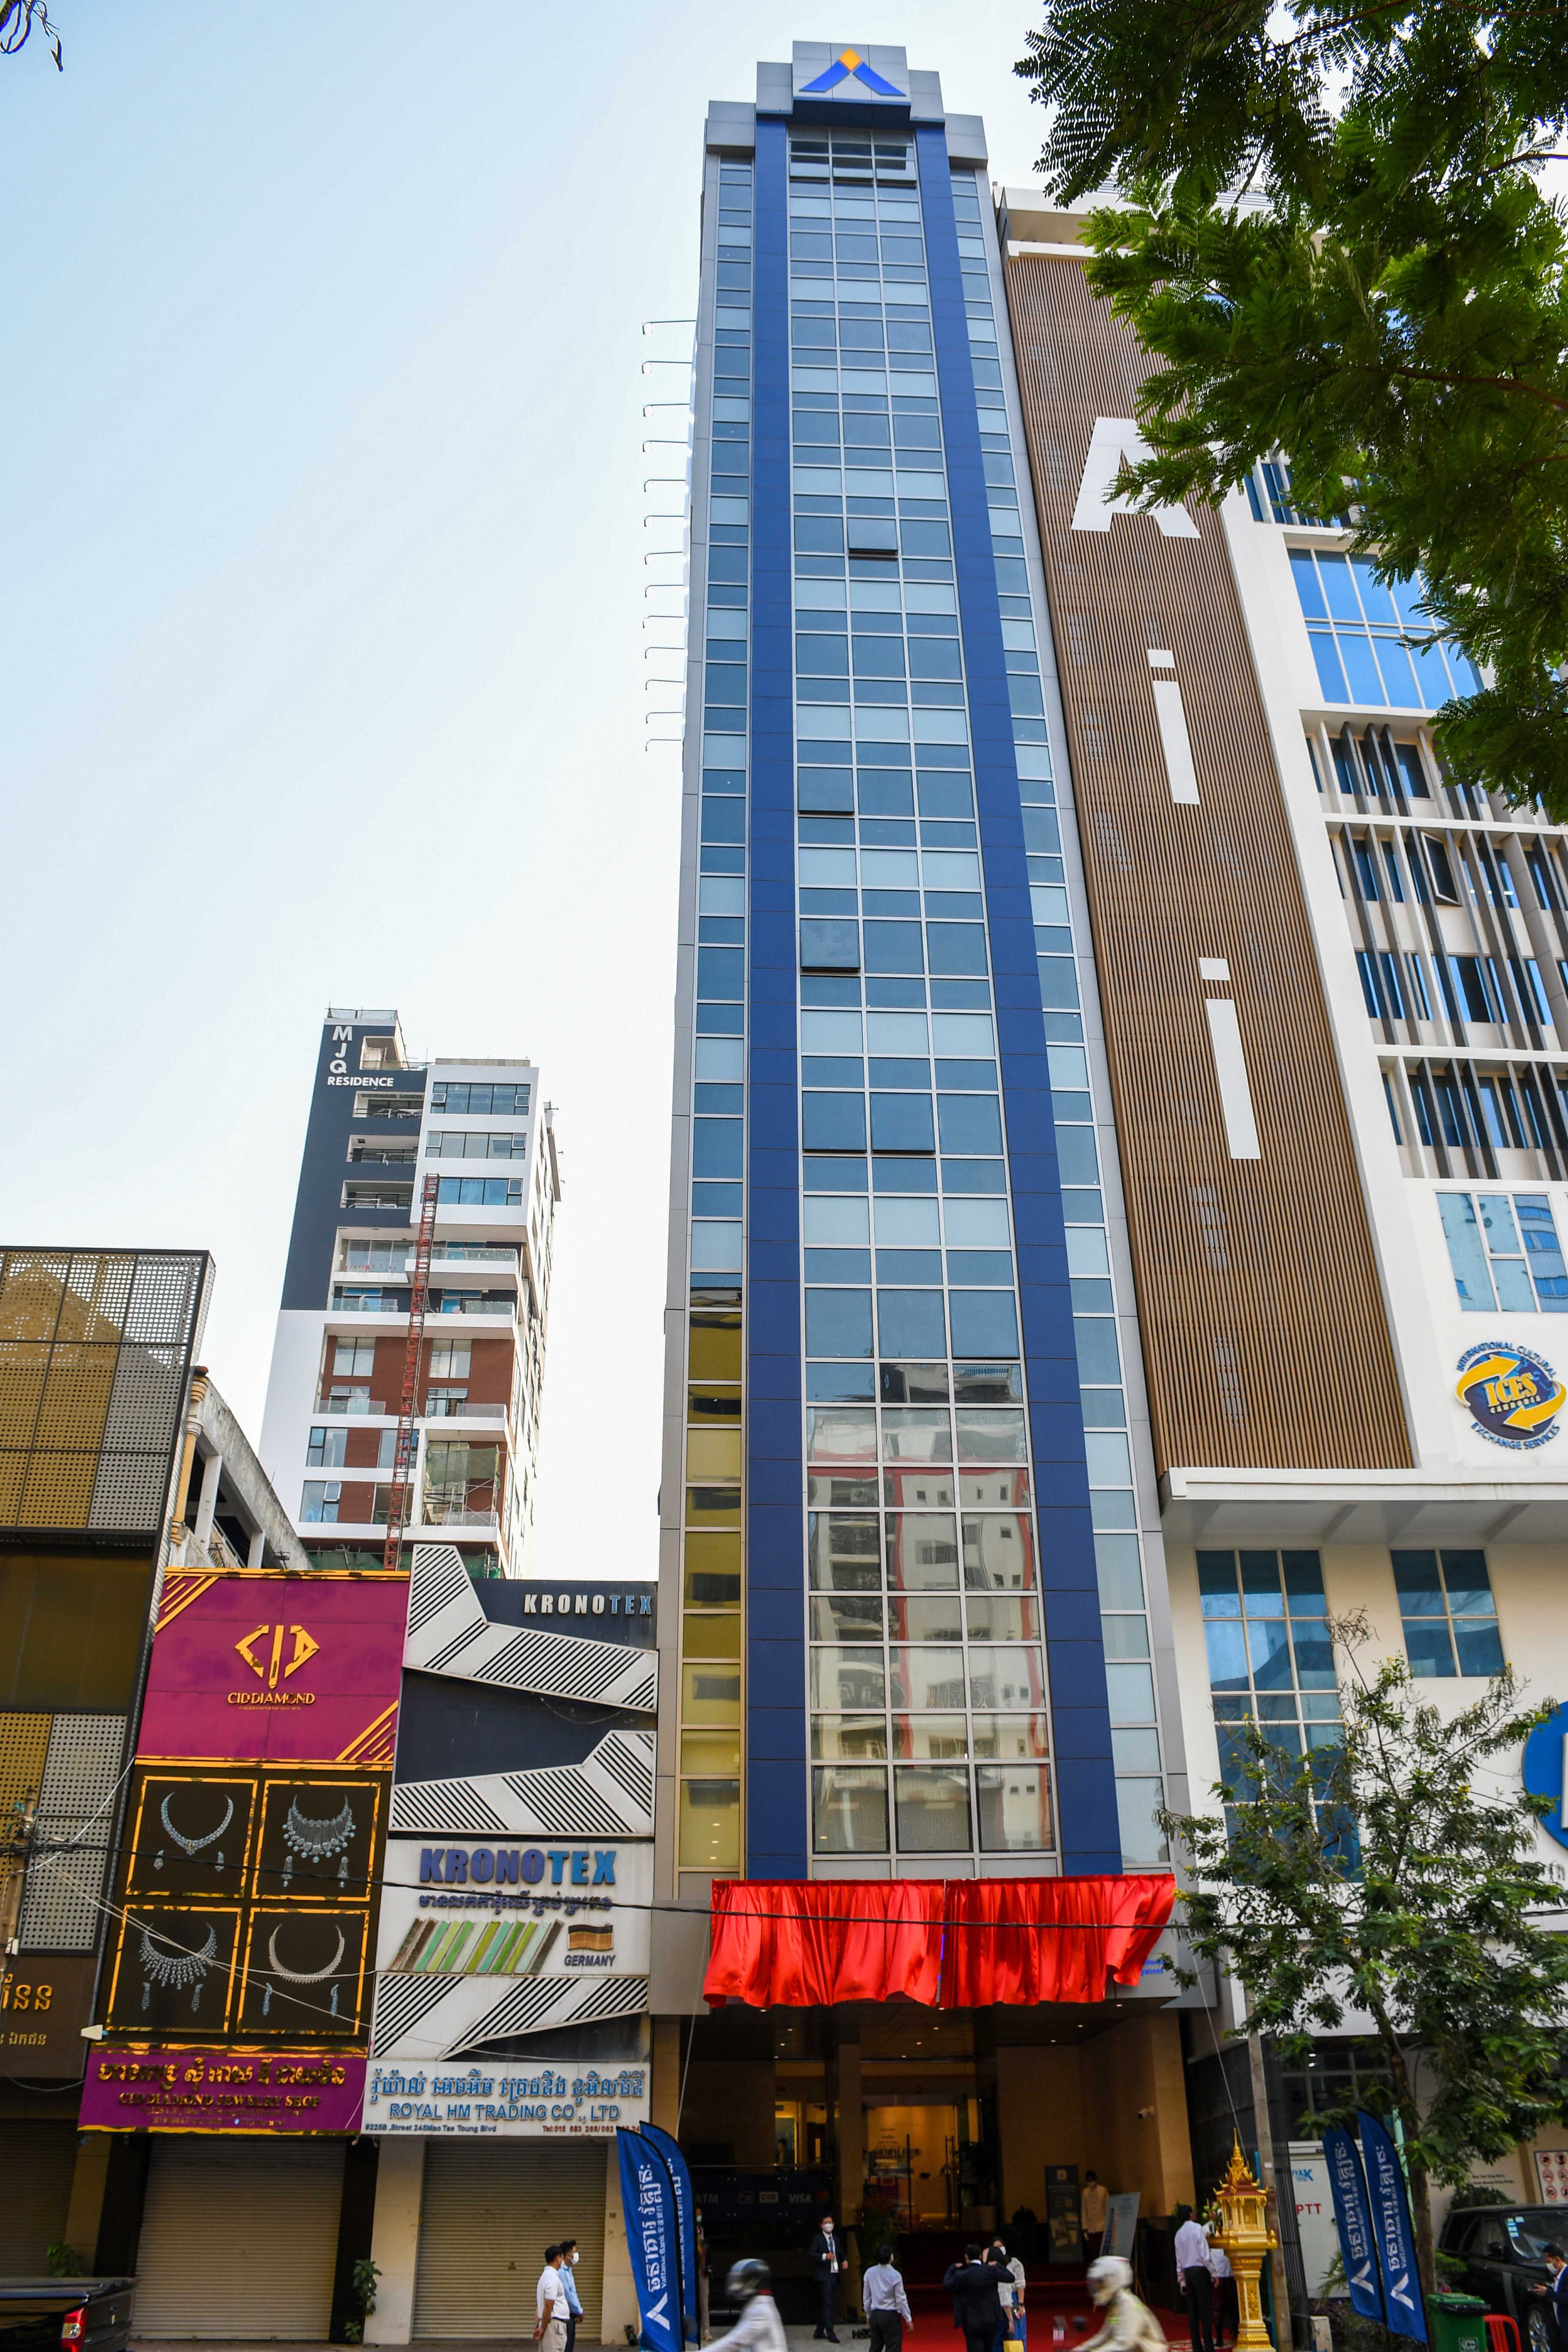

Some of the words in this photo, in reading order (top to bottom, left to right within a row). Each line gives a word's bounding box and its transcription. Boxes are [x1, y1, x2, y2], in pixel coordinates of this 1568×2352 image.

[329, 1026, 352, 1074] MJQ
[327, 1076, 394, 1087] RESIDENCE
[1456, 1341, 1514, 1372] INTERNATIONAL
[1515, 1346, 1557, 1378] CULTURAL
[1483, 1372, 1538, 1407] ICES
[1489, 1396, 1541, 1414] CAMBODIA
[1470, 1421, 1522, 1450] EXCHANGE
[1523, 1424, 1560, 1450] SERVICES
[524, 1594, 652, 1615] KRONOTEX
[227, 1692, 250, 1704] CID
[251, 1693, 316, 1705] DIAMOND
[419, 1848, 617, 1884] KRONOTEX
[564, 1955, 615, 1968] GERMANY
[119, 2092, 144, 2104] CID
[147, 2093, 214, 2106] DIAMOND
[216, 2094, 282, 2107] JEWELRY
[285, 2095, 320, 2108] SHOP
[389, 2103, 442, 2120] ROYAL
[447, 2104, 471, 2120] HM
[476, 2104, 547, 2121] TRADING
[591, 2105, 620, 2121] LTD
[457, 2125, 478, 2133] Toung
[788, 2193, 812, 2203] VISA
[1296, 2203, 1321, 2216] PTT
